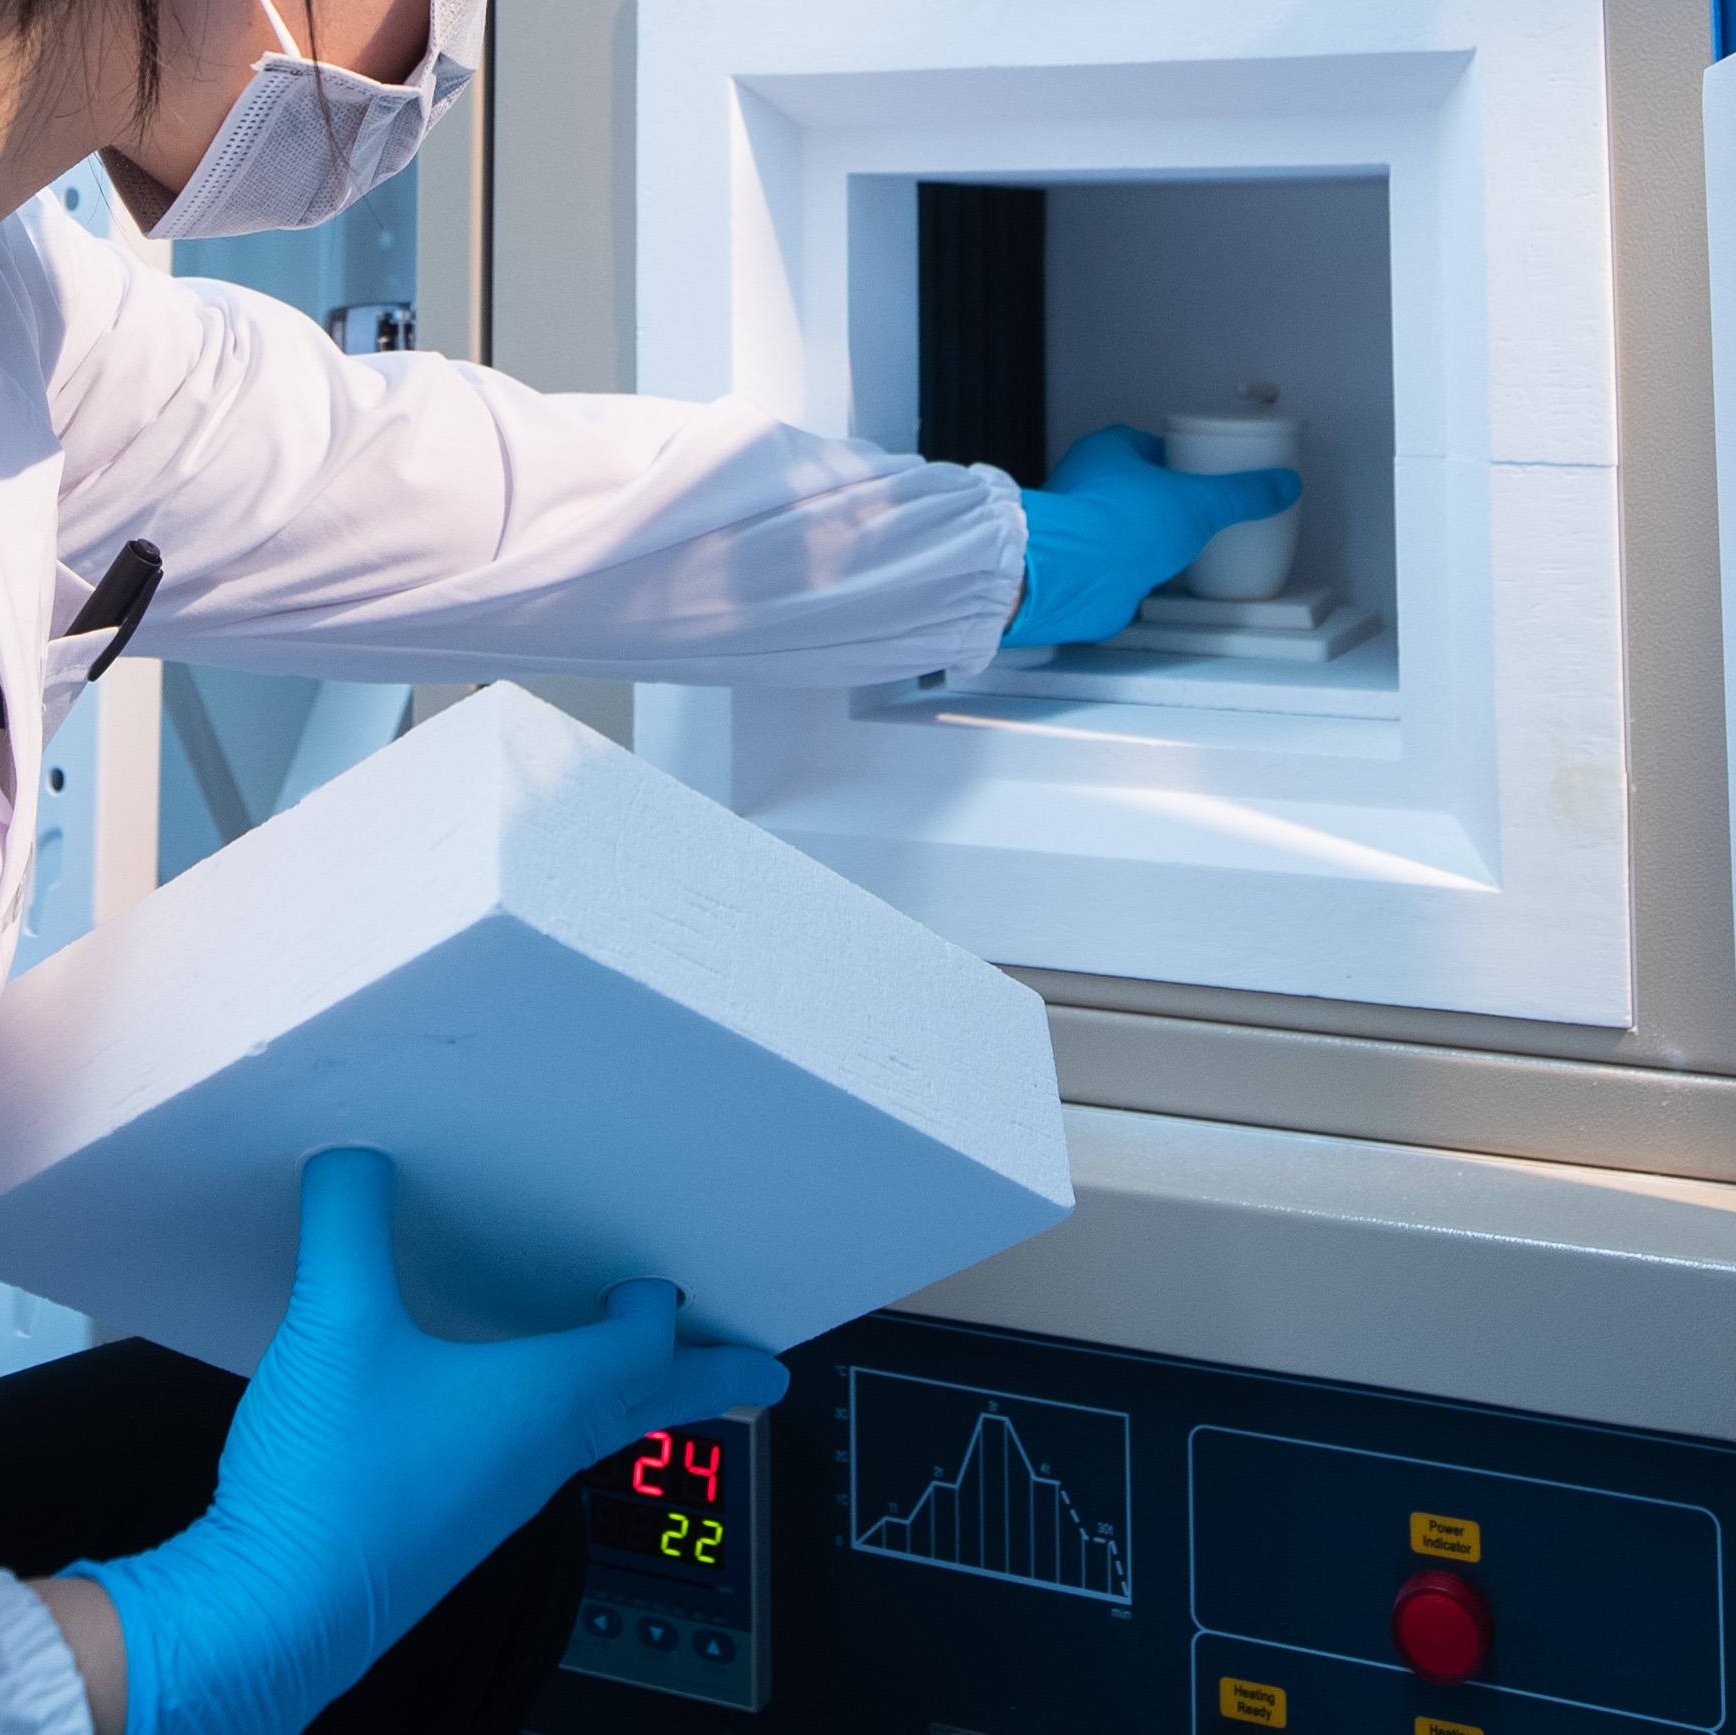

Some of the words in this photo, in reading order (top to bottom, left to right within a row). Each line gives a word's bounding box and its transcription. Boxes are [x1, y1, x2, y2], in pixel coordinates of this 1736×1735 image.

[633, 1431, 719, 1503] 24
[1429, 1519, 1465, 1537] Power
[661, 1513, 723, 1564] 22
[1422, 1535, 1471, 1554] Indicator
[1110, 1606, 1132, 1621] min
[1234, 1684, 1275, 1707] Heating
[1237, 1701, 1272, 1721] Ready
